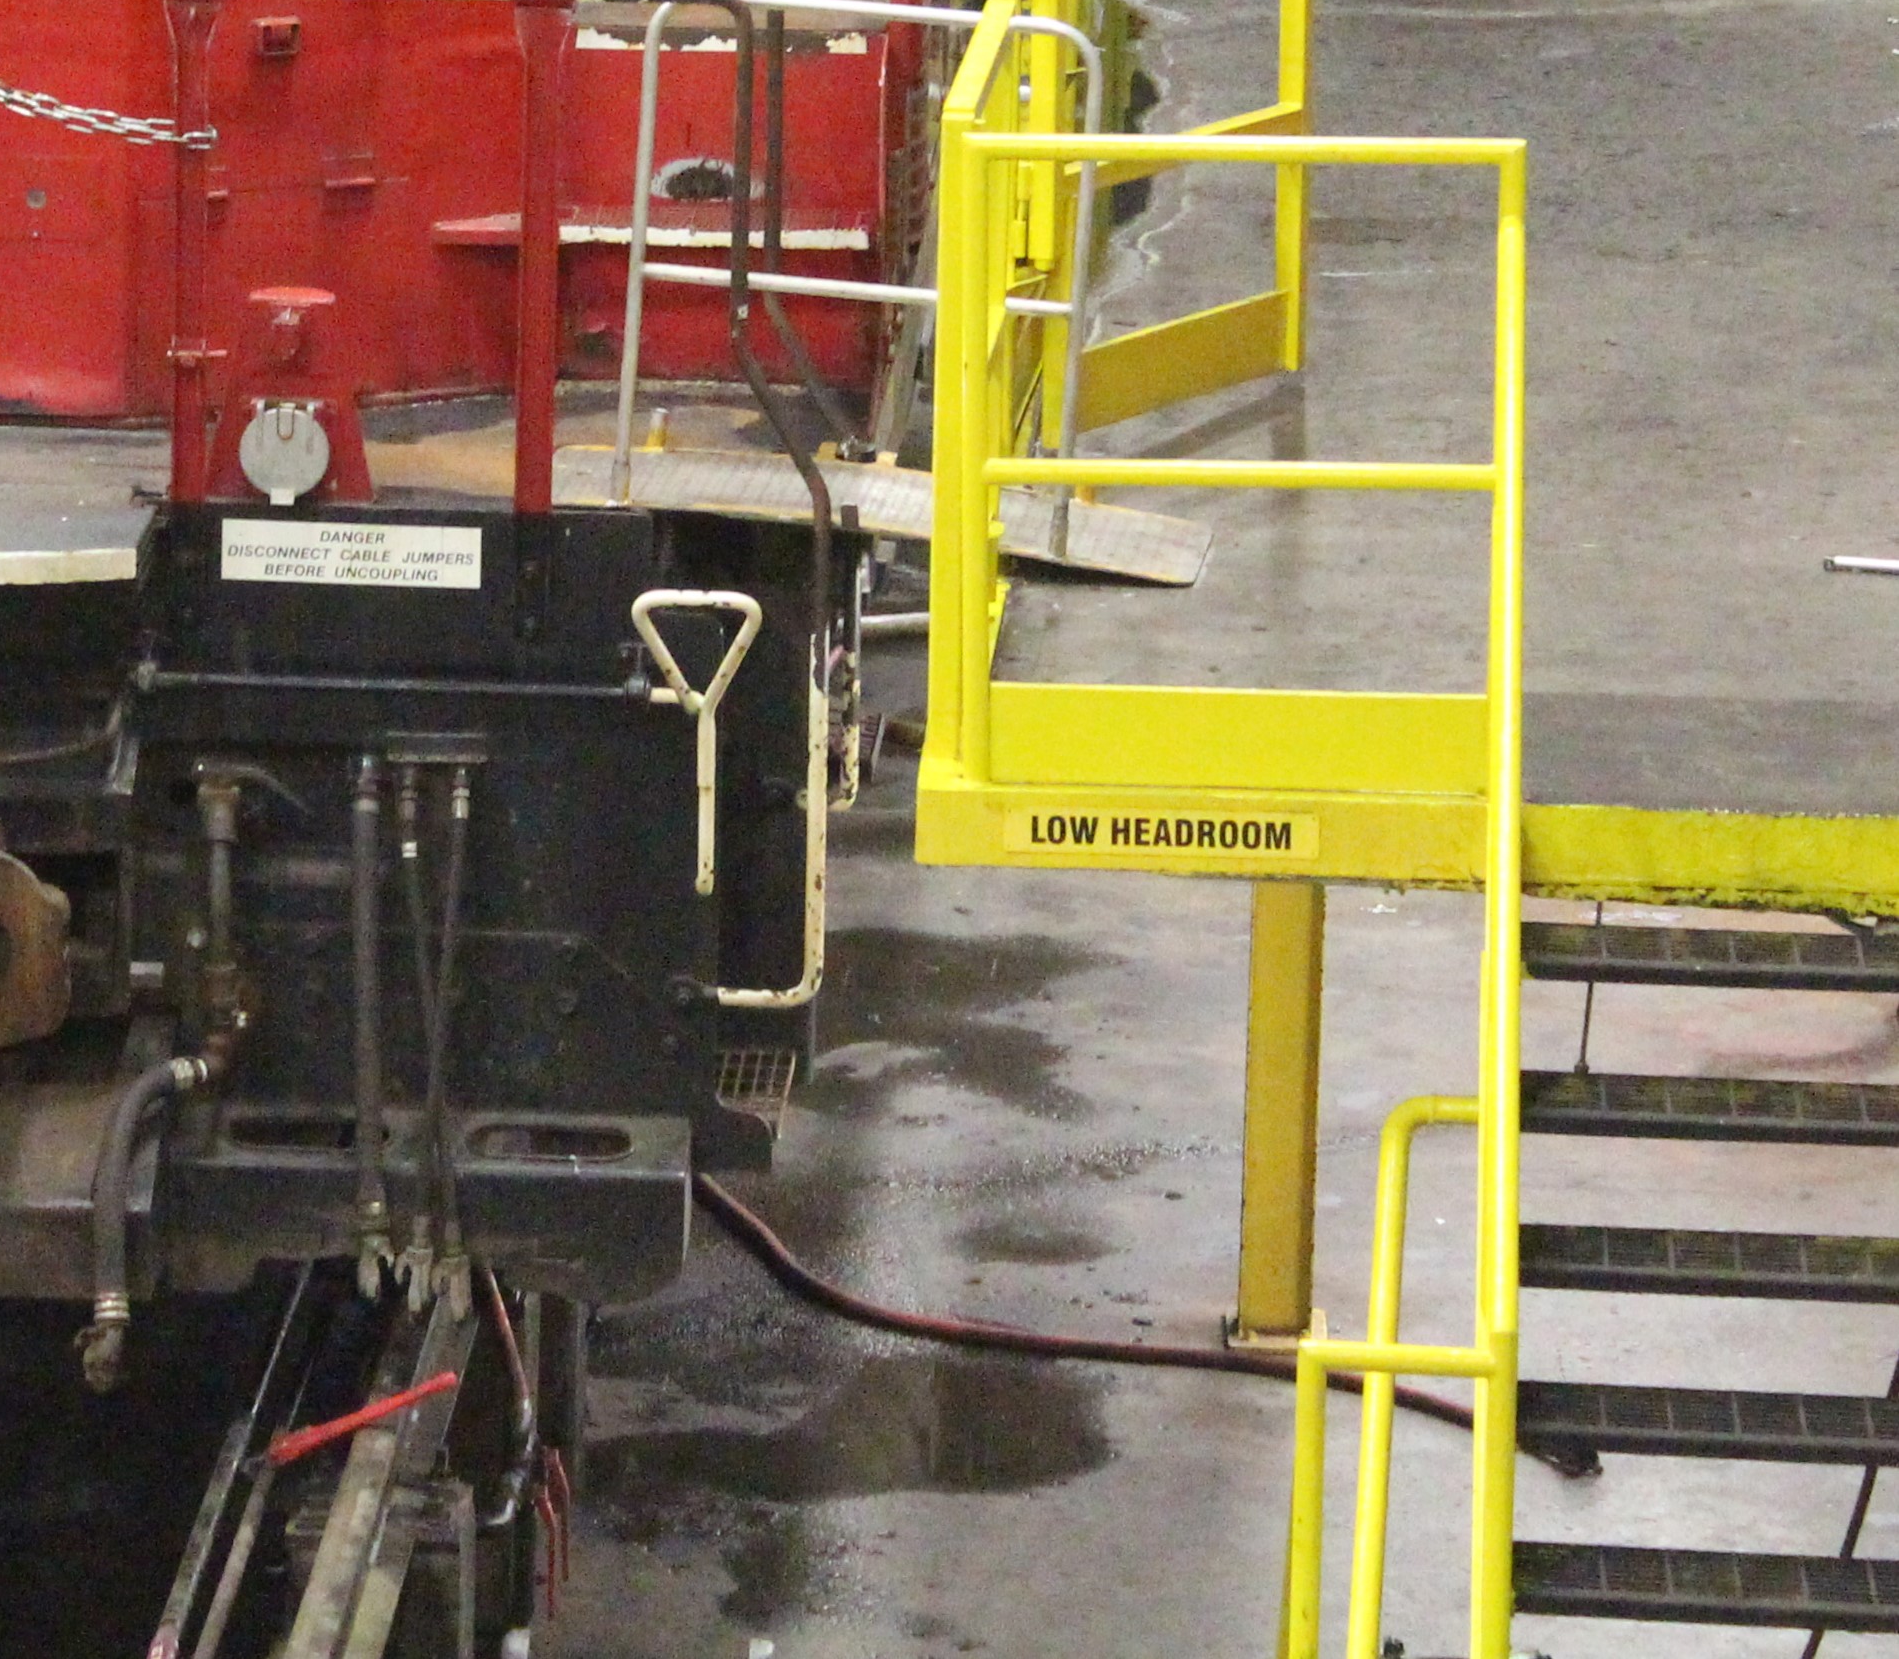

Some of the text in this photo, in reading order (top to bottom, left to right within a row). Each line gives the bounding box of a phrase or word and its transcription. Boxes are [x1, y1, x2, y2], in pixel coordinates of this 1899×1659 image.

[320, 530, 385, 544] DANGER
[227, 545, 474, 565] DISCONNECT CABLE JUMPERS
[264, 564, 438, 581] BEFORE UNCOUPLING
[1031, 815, 1292, 850] LOW HEADROOM
